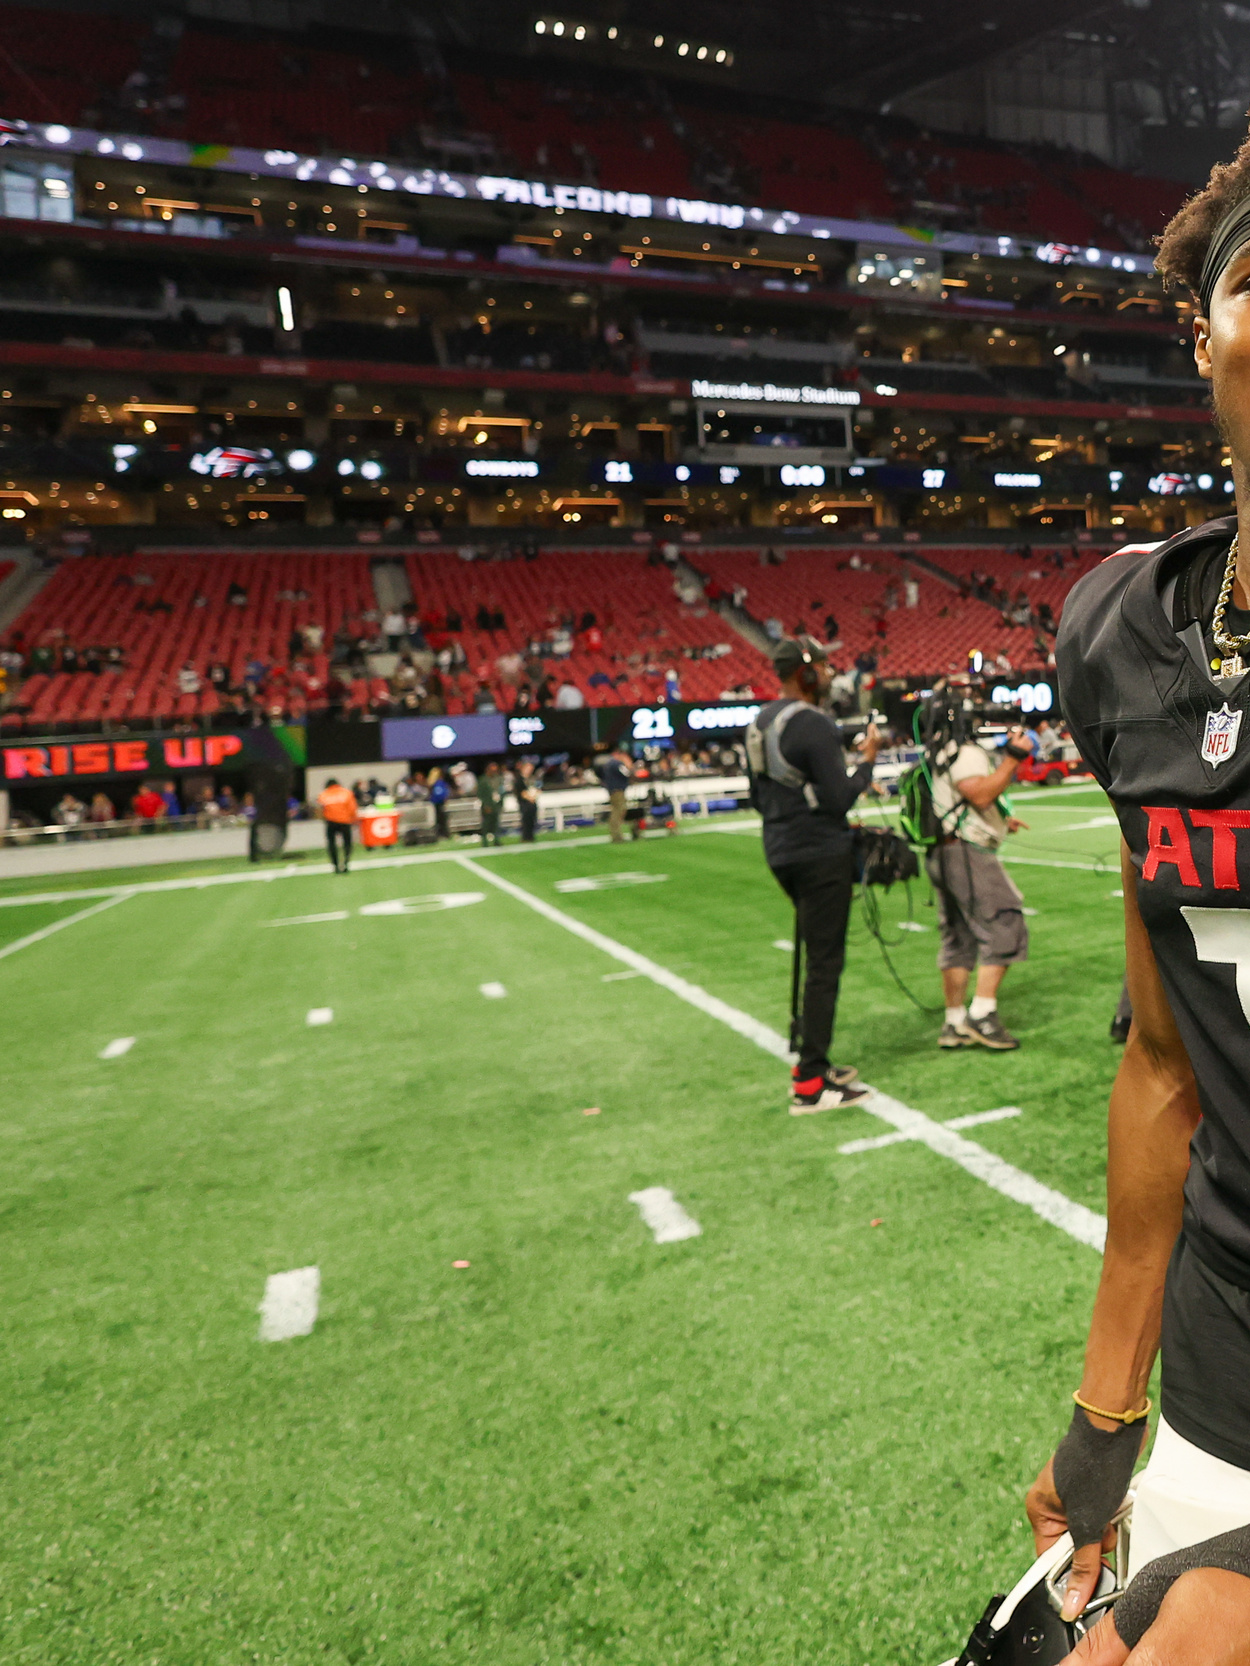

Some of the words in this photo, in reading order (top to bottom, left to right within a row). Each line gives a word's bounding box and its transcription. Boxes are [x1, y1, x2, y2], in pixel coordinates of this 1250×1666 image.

[476, 175, 652, 218] FALCONS
[801, 385, 861, 406] Stadium
[632, 707, 675, 739] 21
[4, 741, 150, 779] RISE
[163, 735, 243, 768] UP
[1206, 732, 1230, 756] NFL
